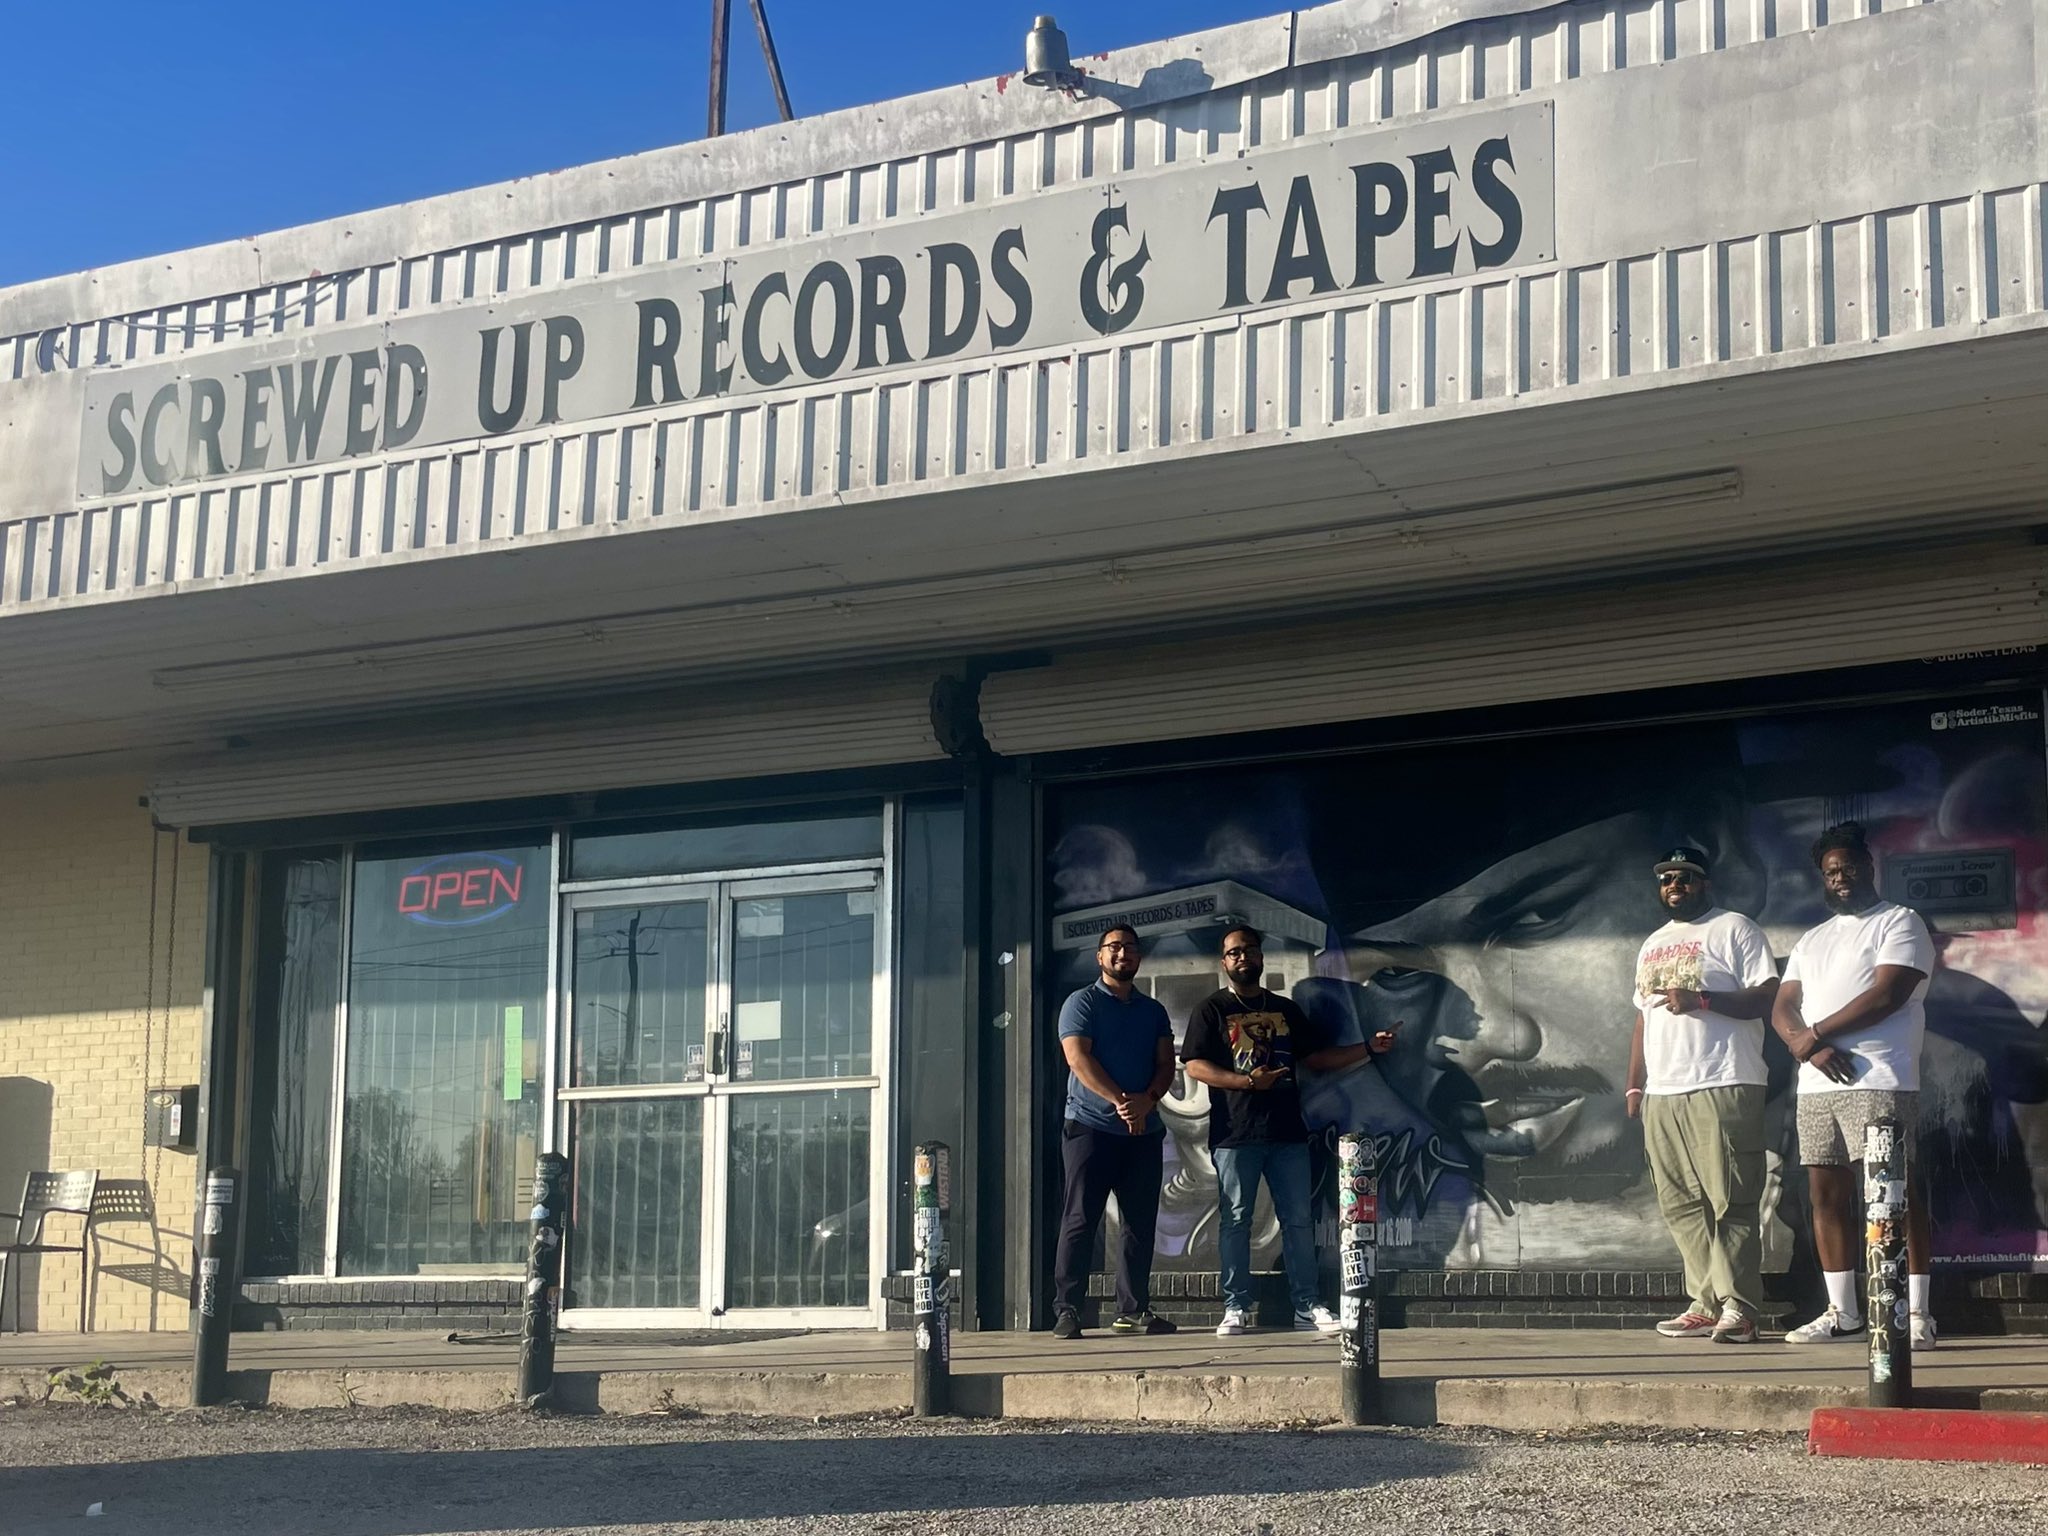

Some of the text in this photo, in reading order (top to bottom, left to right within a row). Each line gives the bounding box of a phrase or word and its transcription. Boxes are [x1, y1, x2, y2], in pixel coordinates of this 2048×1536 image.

[101, 134, 1524, 497] SCREWED UP RECORDS & TAPES
[398, 865, 522, 912] OPEN
[1067, 917, 1113, 938] SCREWED
[1129, 907, 1173, 928] RECORDS
[1175, 904, 1182, 918] &
[1185, 898, 1215, 915] TAPES
[1346, 1263, 1362, 1275] EYE
[916, 1279, 930, 1289] RED
[916, 1290, 930, 1300] EYE
[916, 1300, 932, 1311] MOB
